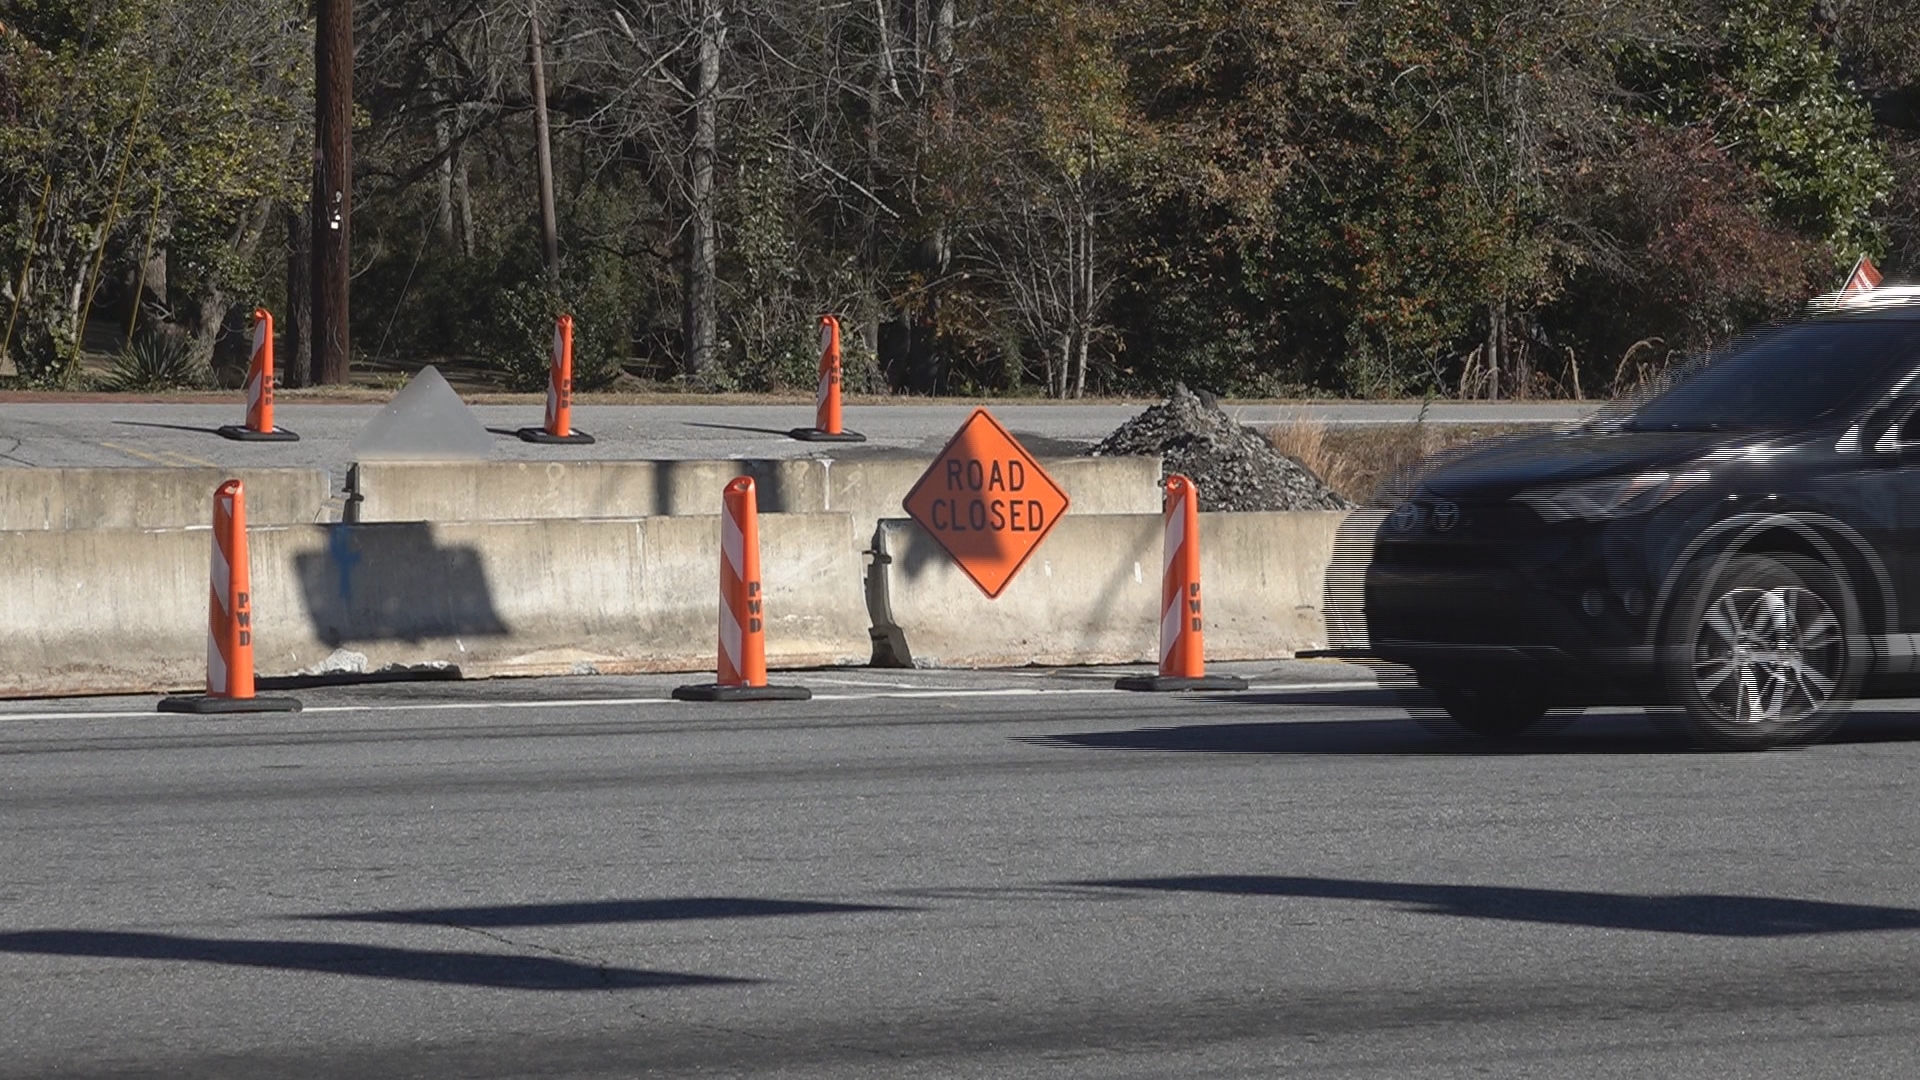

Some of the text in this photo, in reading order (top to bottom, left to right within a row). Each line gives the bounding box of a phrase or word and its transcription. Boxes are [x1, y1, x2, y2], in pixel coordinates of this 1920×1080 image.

[946, 459, 1025, 491] ROAD
[931, 499, 1044, 532] CLOSED
[236, 592, 251, 646] PWD
[748, 582, 762, 633] PWD
[1189, 583, 1202, 632] PWD
